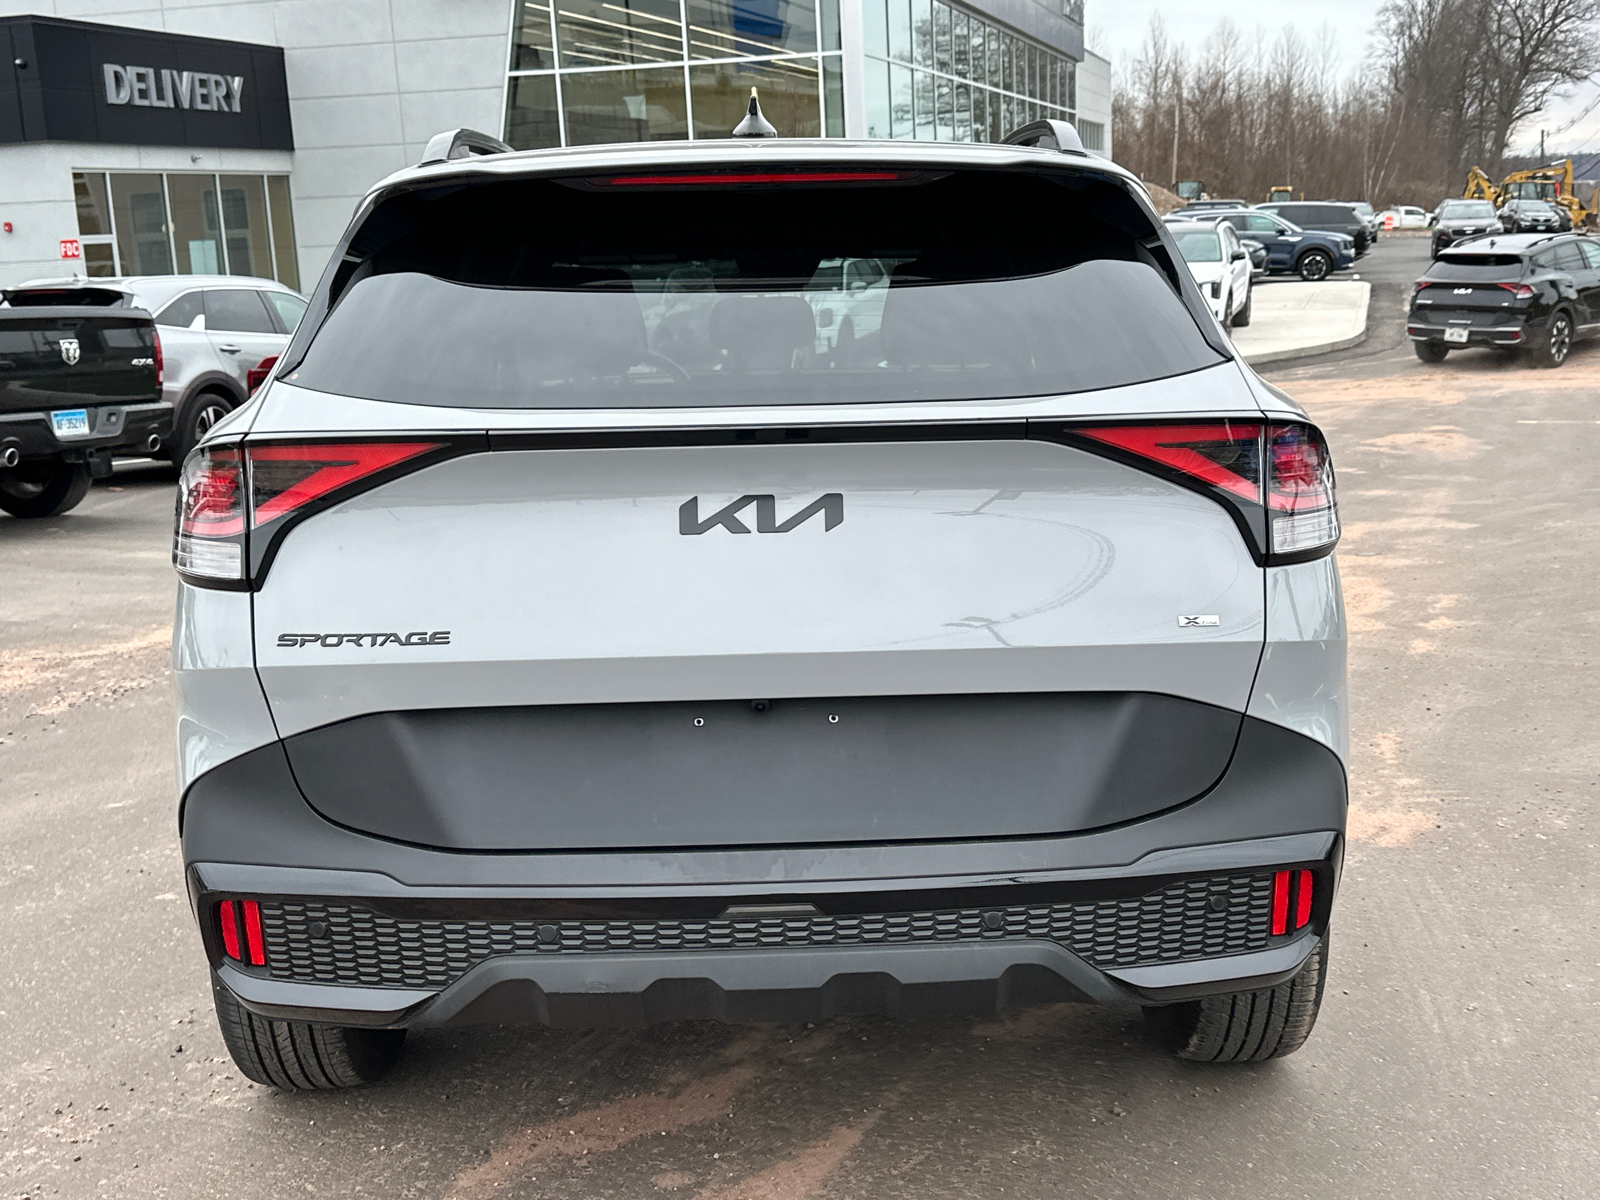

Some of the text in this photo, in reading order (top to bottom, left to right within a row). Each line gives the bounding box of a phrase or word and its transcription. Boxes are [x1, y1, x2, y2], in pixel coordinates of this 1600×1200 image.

[103, 63, 244, 113] DELIVERY
[61, 242, 79, 256] FDC
[679, 492, 844, 536] KIA
[276, 630, 451, 648] SPORTAGE
